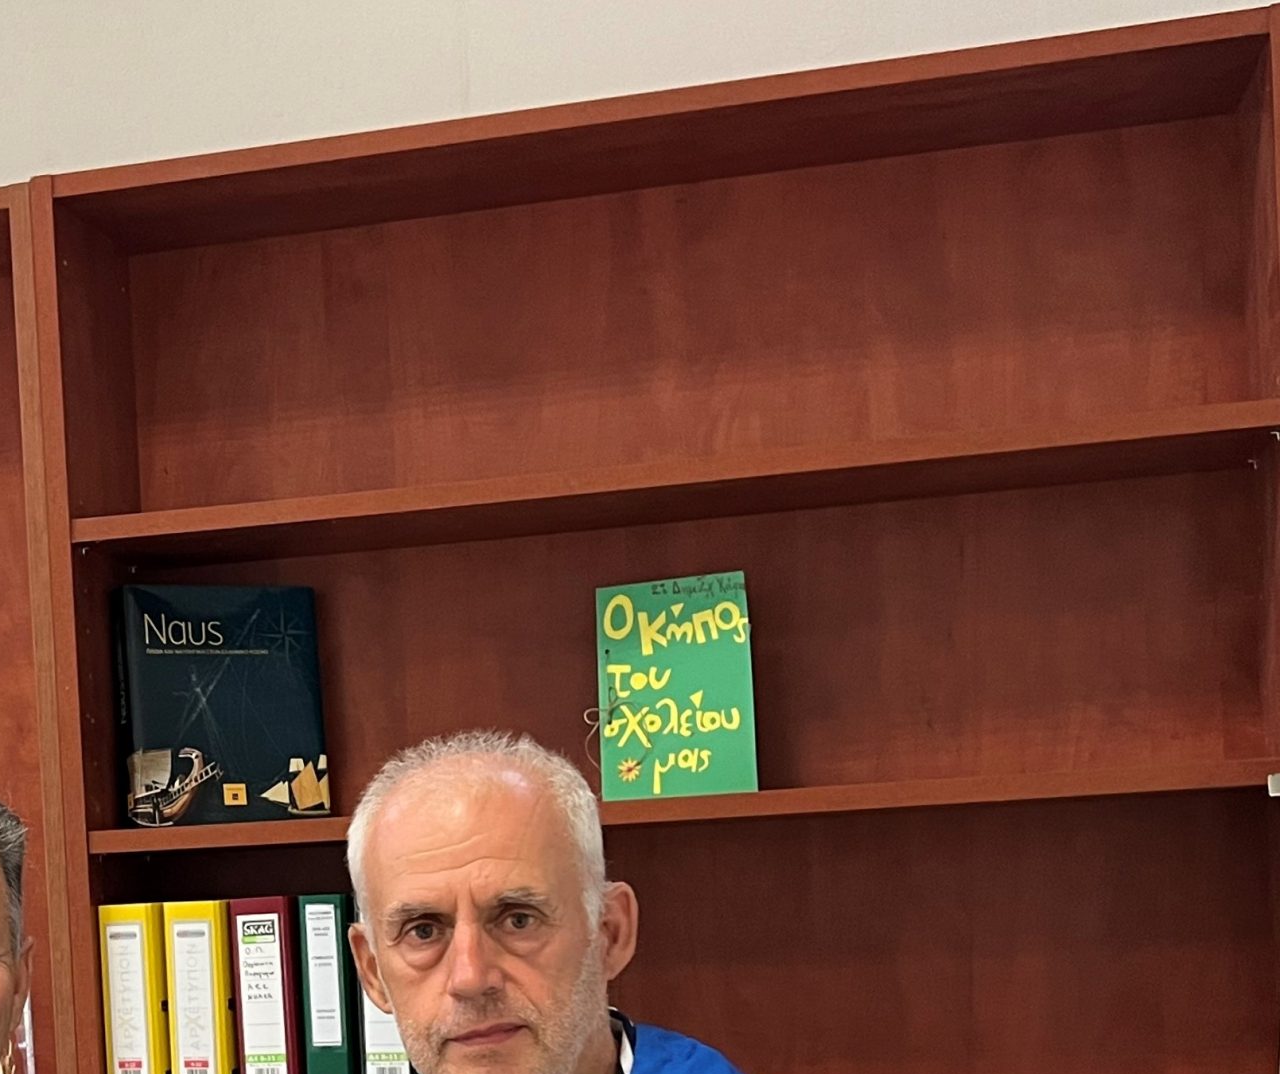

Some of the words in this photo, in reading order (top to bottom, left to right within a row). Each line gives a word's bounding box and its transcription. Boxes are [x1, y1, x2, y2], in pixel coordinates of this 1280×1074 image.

[144, 613, 223, 645] Naus
[607, 665, 671, 697] του
[243, 922, 274, 935] SKAG
